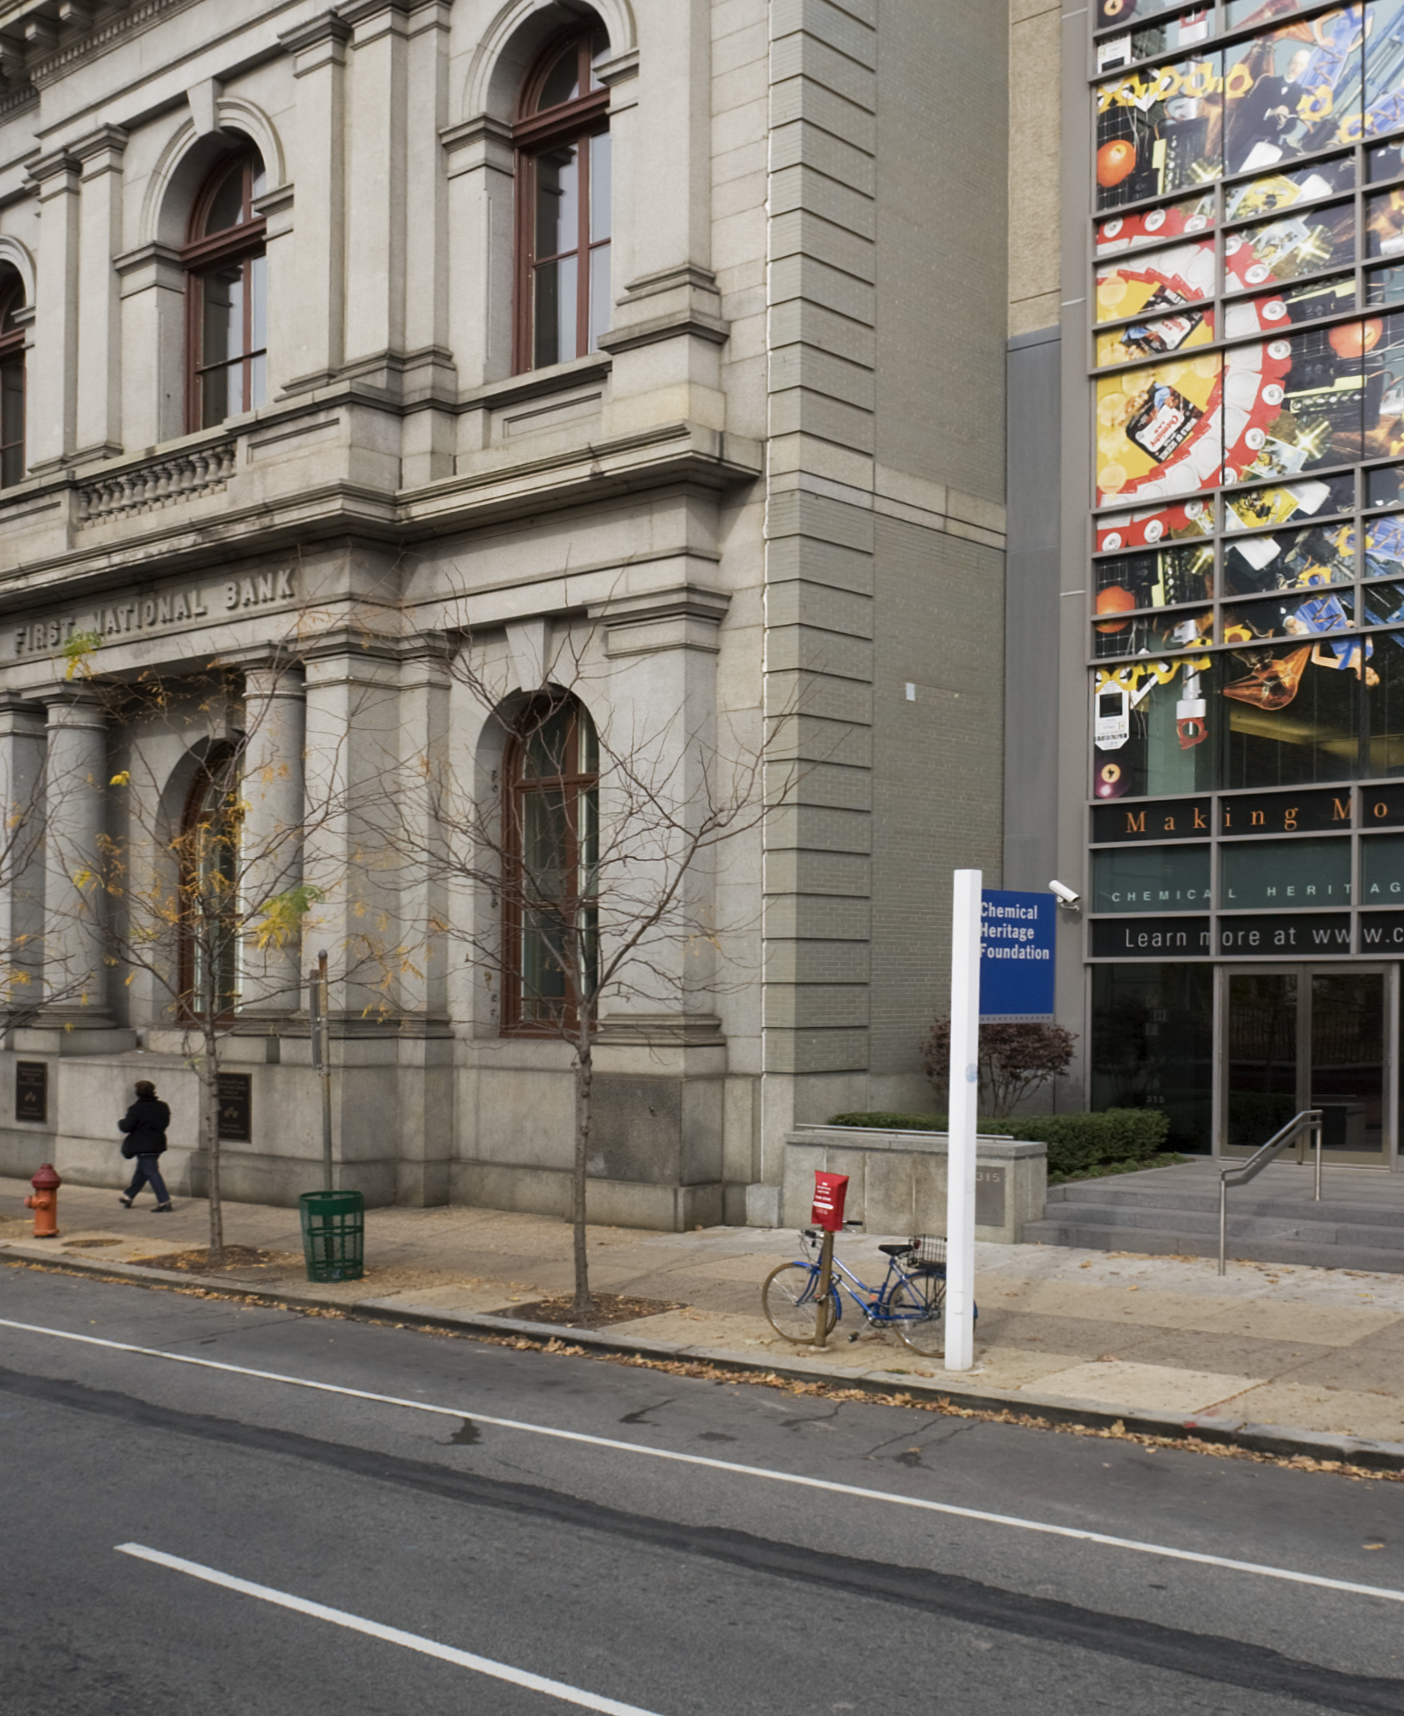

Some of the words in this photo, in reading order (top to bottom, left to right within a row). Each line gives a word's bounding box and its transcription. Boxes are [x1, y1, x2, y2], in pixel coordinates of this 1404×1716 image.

[1150, 415, 1179, 447] Chemistry
[14, 616, 76, 654] FIRST
[92, 589, 208, 636] NATIONAL
[224, 568, 296, 610] BANK
[1125, 806, 1299, 831] Making
[1111, 888, 1236, 902] CHEMICAL
[980, 902, 1037, 919] Chemical
[980, 922, 1034, 941] Heritage
[1125, 928, 1187, 947] Learn
[1274, 927, 1297, 945] at
[979, 943, 1049, 959] Foundation
[975, 1171, 1000, 1182] 315
